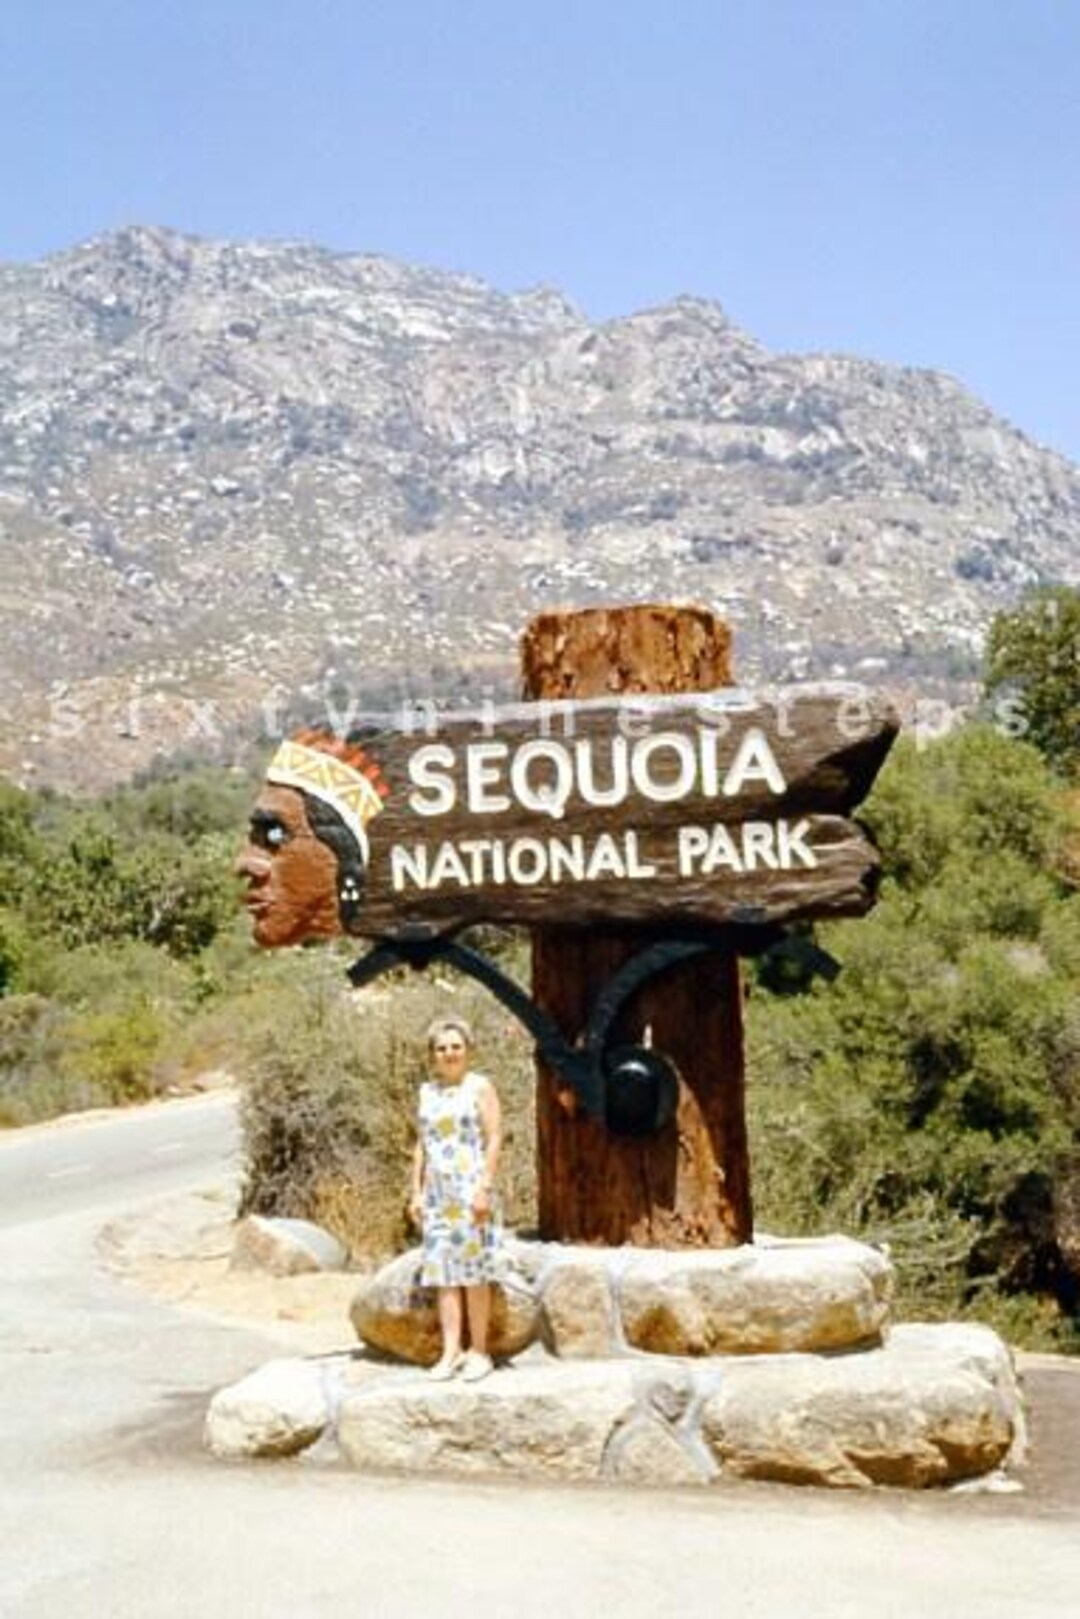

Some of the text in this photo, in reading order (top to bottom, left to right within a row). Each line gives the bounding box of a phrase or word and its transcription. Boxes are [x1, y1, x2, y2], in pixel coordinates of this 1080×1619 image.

[409, 730, 786, 818] SEQUOIA
[391, 819, 820, 891] NATIONAL PARK
